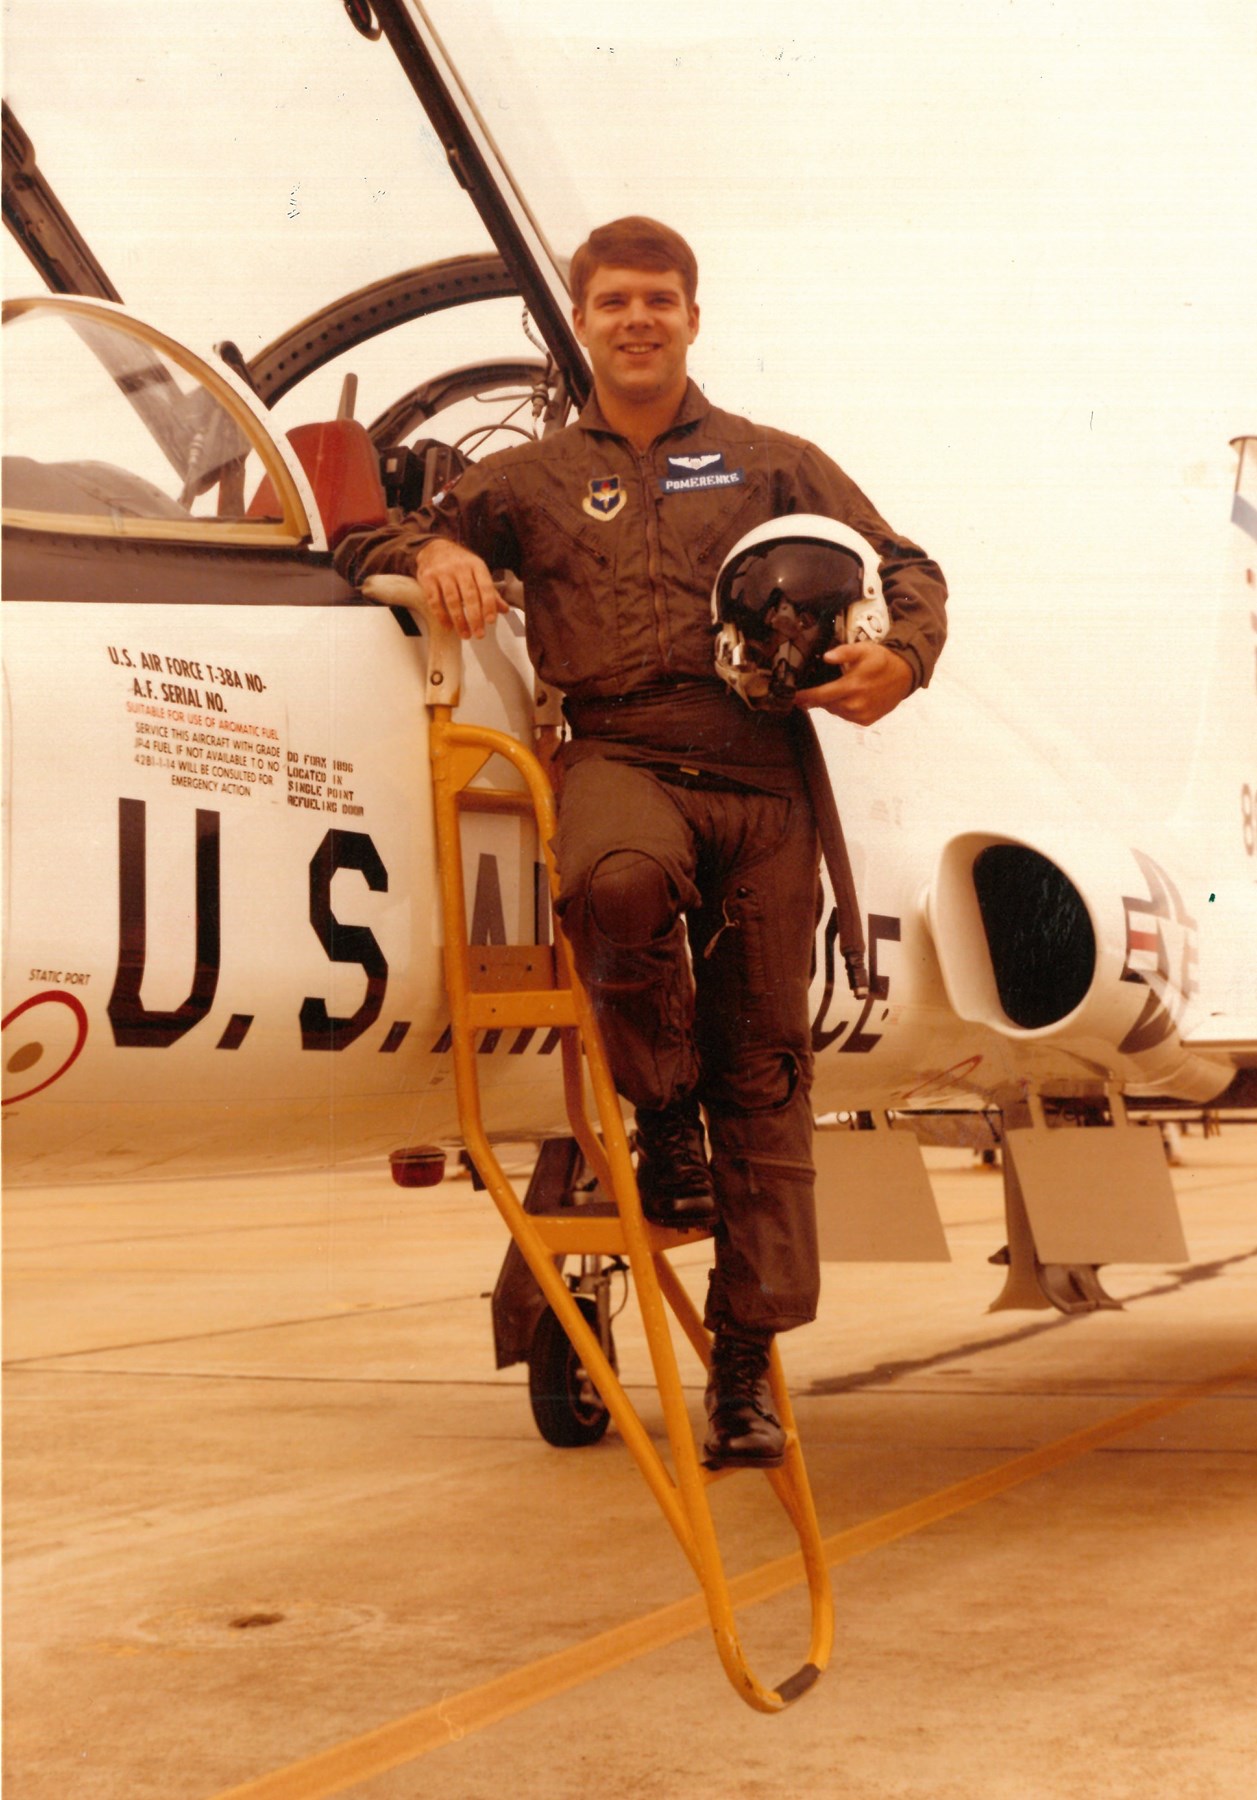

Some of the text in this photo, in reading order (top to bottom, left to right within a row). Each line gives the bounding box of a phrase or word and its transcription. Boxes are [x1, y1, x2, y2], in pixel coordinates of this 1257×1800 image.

[665, 472, 740, 490] POMERENKE
[107, 646, 136, 668] U.S.
[140, 652, 163, 673] AIR
[165, 656, 204, 681] FORCE
[206, 664, 243, 689] T-38A
[133, 677, 228, 713] A.F. SERIAL NO.
[126, 701, 280, 740] SUITABLE FOR USE OF AROMATIC FUEL
[135, 722, 280, 758] SERVICE THIS AIRCRAFT WITH GRADE
[153, 740, 172, 754] FUEL
[176, 744, 183, 755] IF
[186, 747, 203, 759] NOT
[206, 750, 247, 767] AVAILABLE
[267, 761, 280, 772] NO
[171, 774, 251, 796] EMERGENCY ACTION
[178, 760, 198, 774] WILL
[200, 763, 209, 775] BE
[212, 766, 256, 783] CONSULTED
[259, 773, 273, 785] FOR
[287, 765, 343, 785] LOCATED IN
[288, 781, 354, 801] SINGLE POINT
[287, 795, 364, 817] REFUELING DOOR
[107, 797, 411, 1053] U.S.
[28, 969, 91, 986] STATIC PORT
